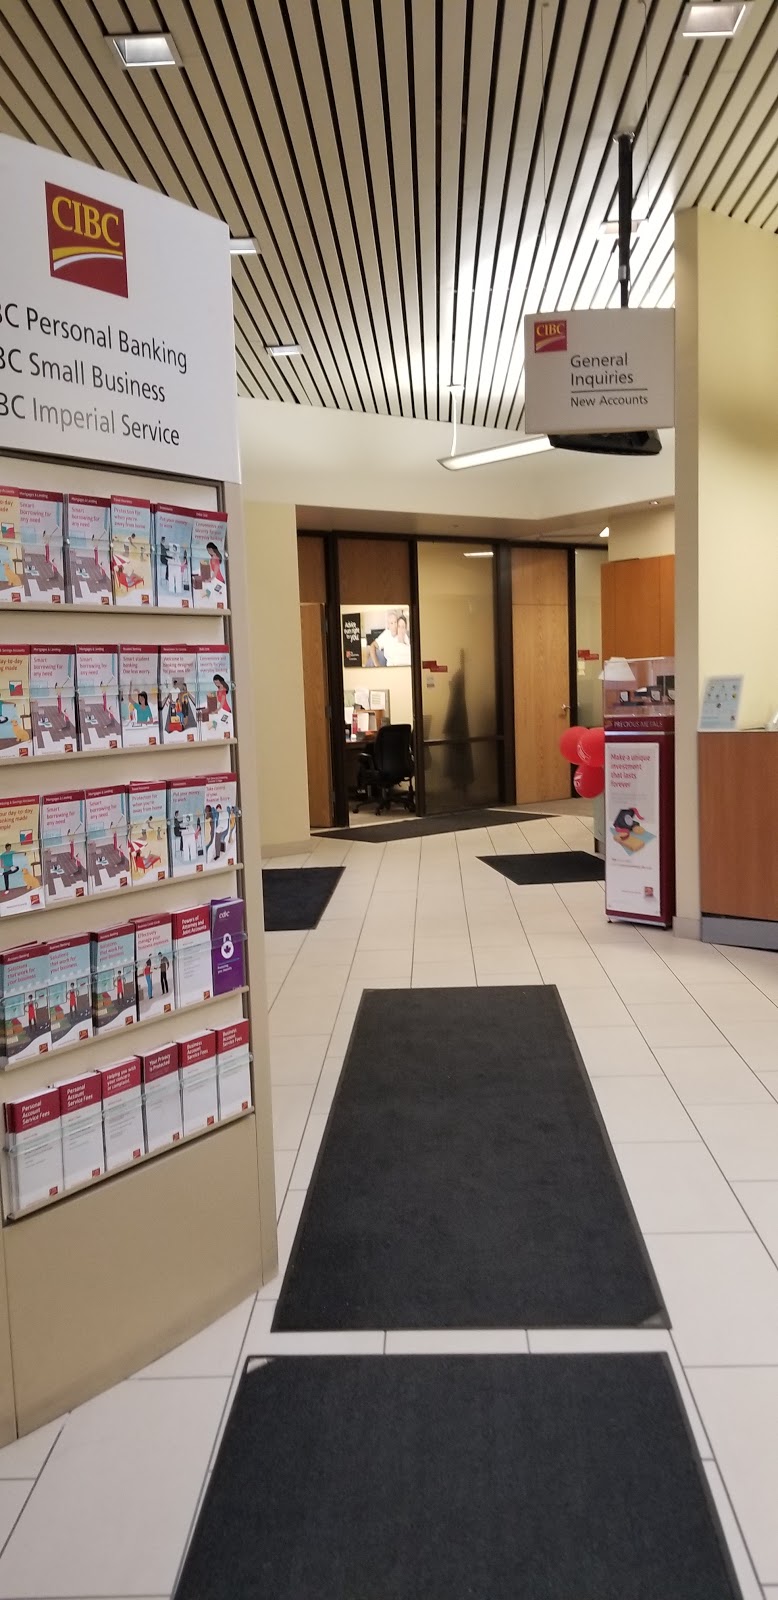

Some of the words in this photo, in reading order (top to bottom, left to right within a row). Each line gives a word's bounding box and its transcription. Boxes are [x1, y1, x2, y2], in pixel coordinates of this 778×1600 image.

[52, 196, 120, 246] CIBC
[536, 324, 564, 336] CIBC
[26, 306, 112, 350] Personal
[118, 330, 187, 374] Banking
[570, 352, 628, 368] General
[30, 352, 84, 386] Small
[92, 364, 165, 403] Business
[571, 370, 634, 388] Inquiries
[570, 396, 595, 408] New
[599, 395, 648, 406] Accounts
[33, 397, 115, 434] Imperial
[122, 414, 180, 446] Service
[219, 910, 230, 918] cdic
[182, 917, 194, 925] Powers
[138, 930, 157, 938] Effectively
[50, 952, 68, 960] Solutions
[8, 963, 27, 972] Solutions
[18, 974, 36, 982] business
[223, 1028, 237, 1036] Business
[187, 1041, 202, 1049] Business
[158, 1054, 170, 1063] Privacy
[153, 1060, 170, 1070] Protected
[107, 1071, 120, 1080] Helping
[116, 1073, 130, 1083] concern
[112, 1079, 130, 1089] complaint
[67, 1084, 86, 1095] Personal
[67, 1091, 84, 1101] Account
[67, 1098, 83, 1107] Service
[83, 1094, 93, 1102] Fees
[22, 1100, 42, 1112] Personal
[22, 1107, 41, 1119] Account
[22, 1115, 39, 1125] Service
[39, 1111, 50, 1119] Fees
